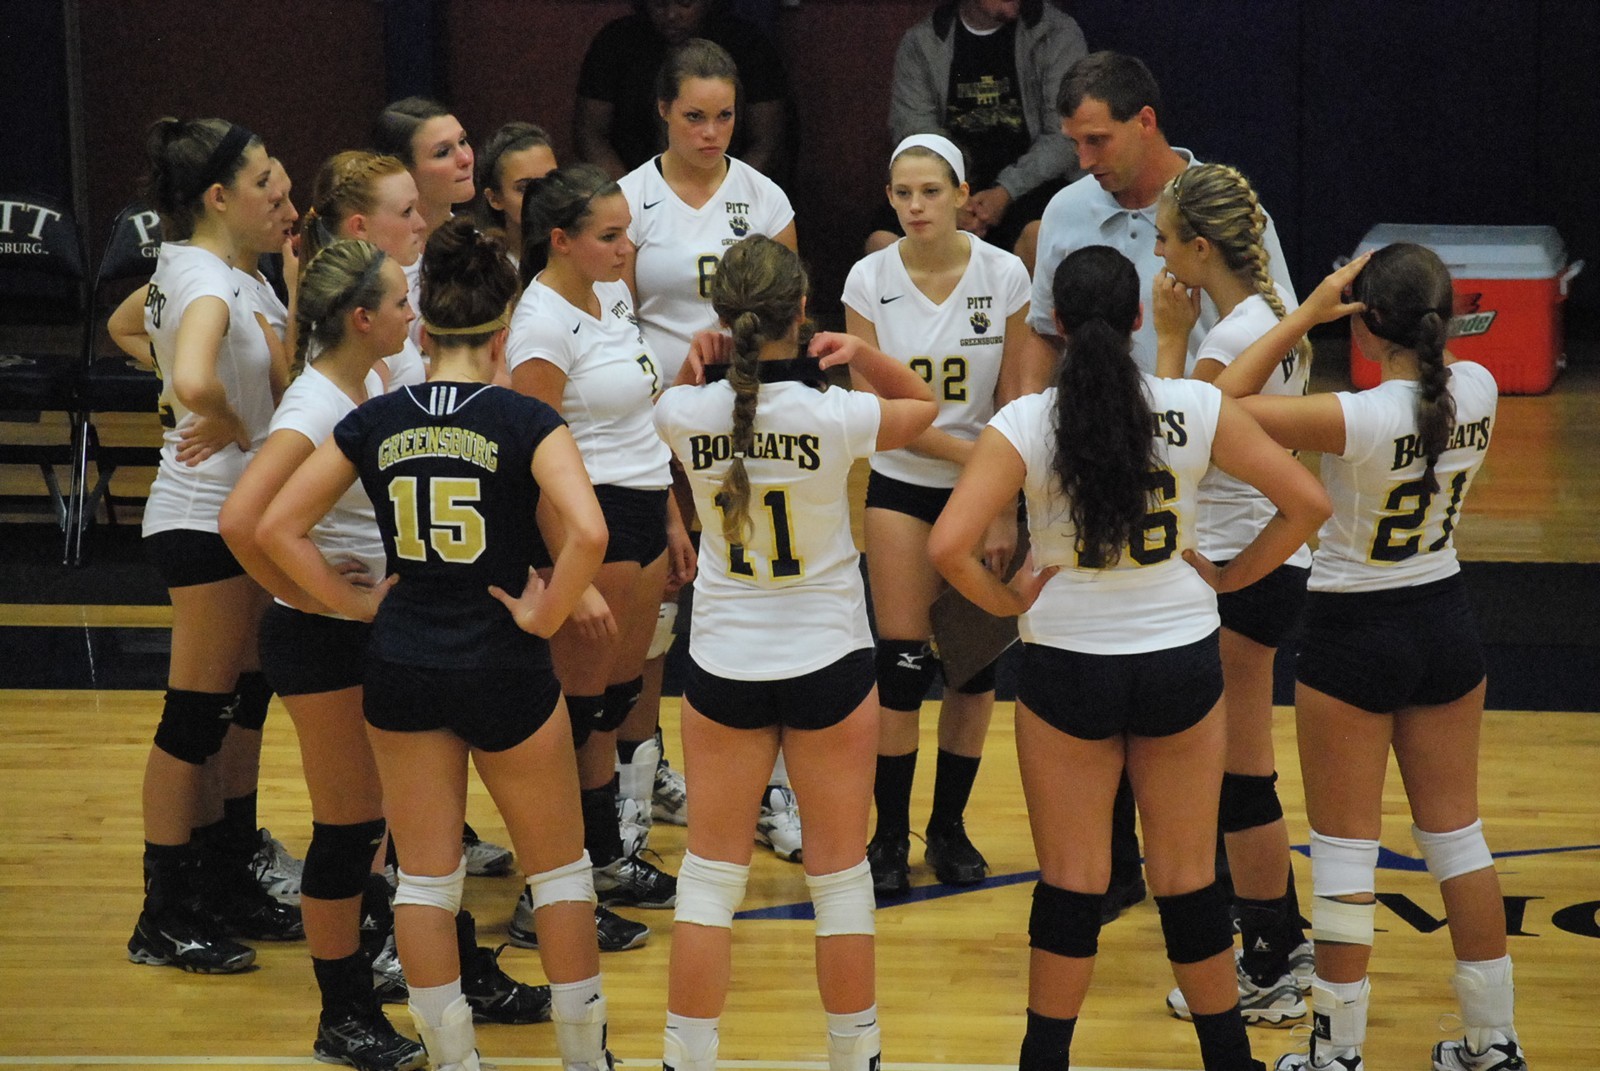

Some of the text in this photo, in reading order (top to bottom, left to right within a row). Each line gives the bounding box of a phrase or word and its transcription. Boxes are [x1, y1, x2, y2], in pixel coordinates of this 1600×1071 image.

[726, 202, 749, 214] PITT
[611, 300, 629, 320] PITT
[967, 297, 993, 309] PITT
[378, 426, 499, 473] GREENSBURG
[689, 432, 820, 470] BOCATS
[1391, 416, 1490, 471] BOATS
[388, 476, 486, 564] 15
[1367, 470, 1468, 564] 21
